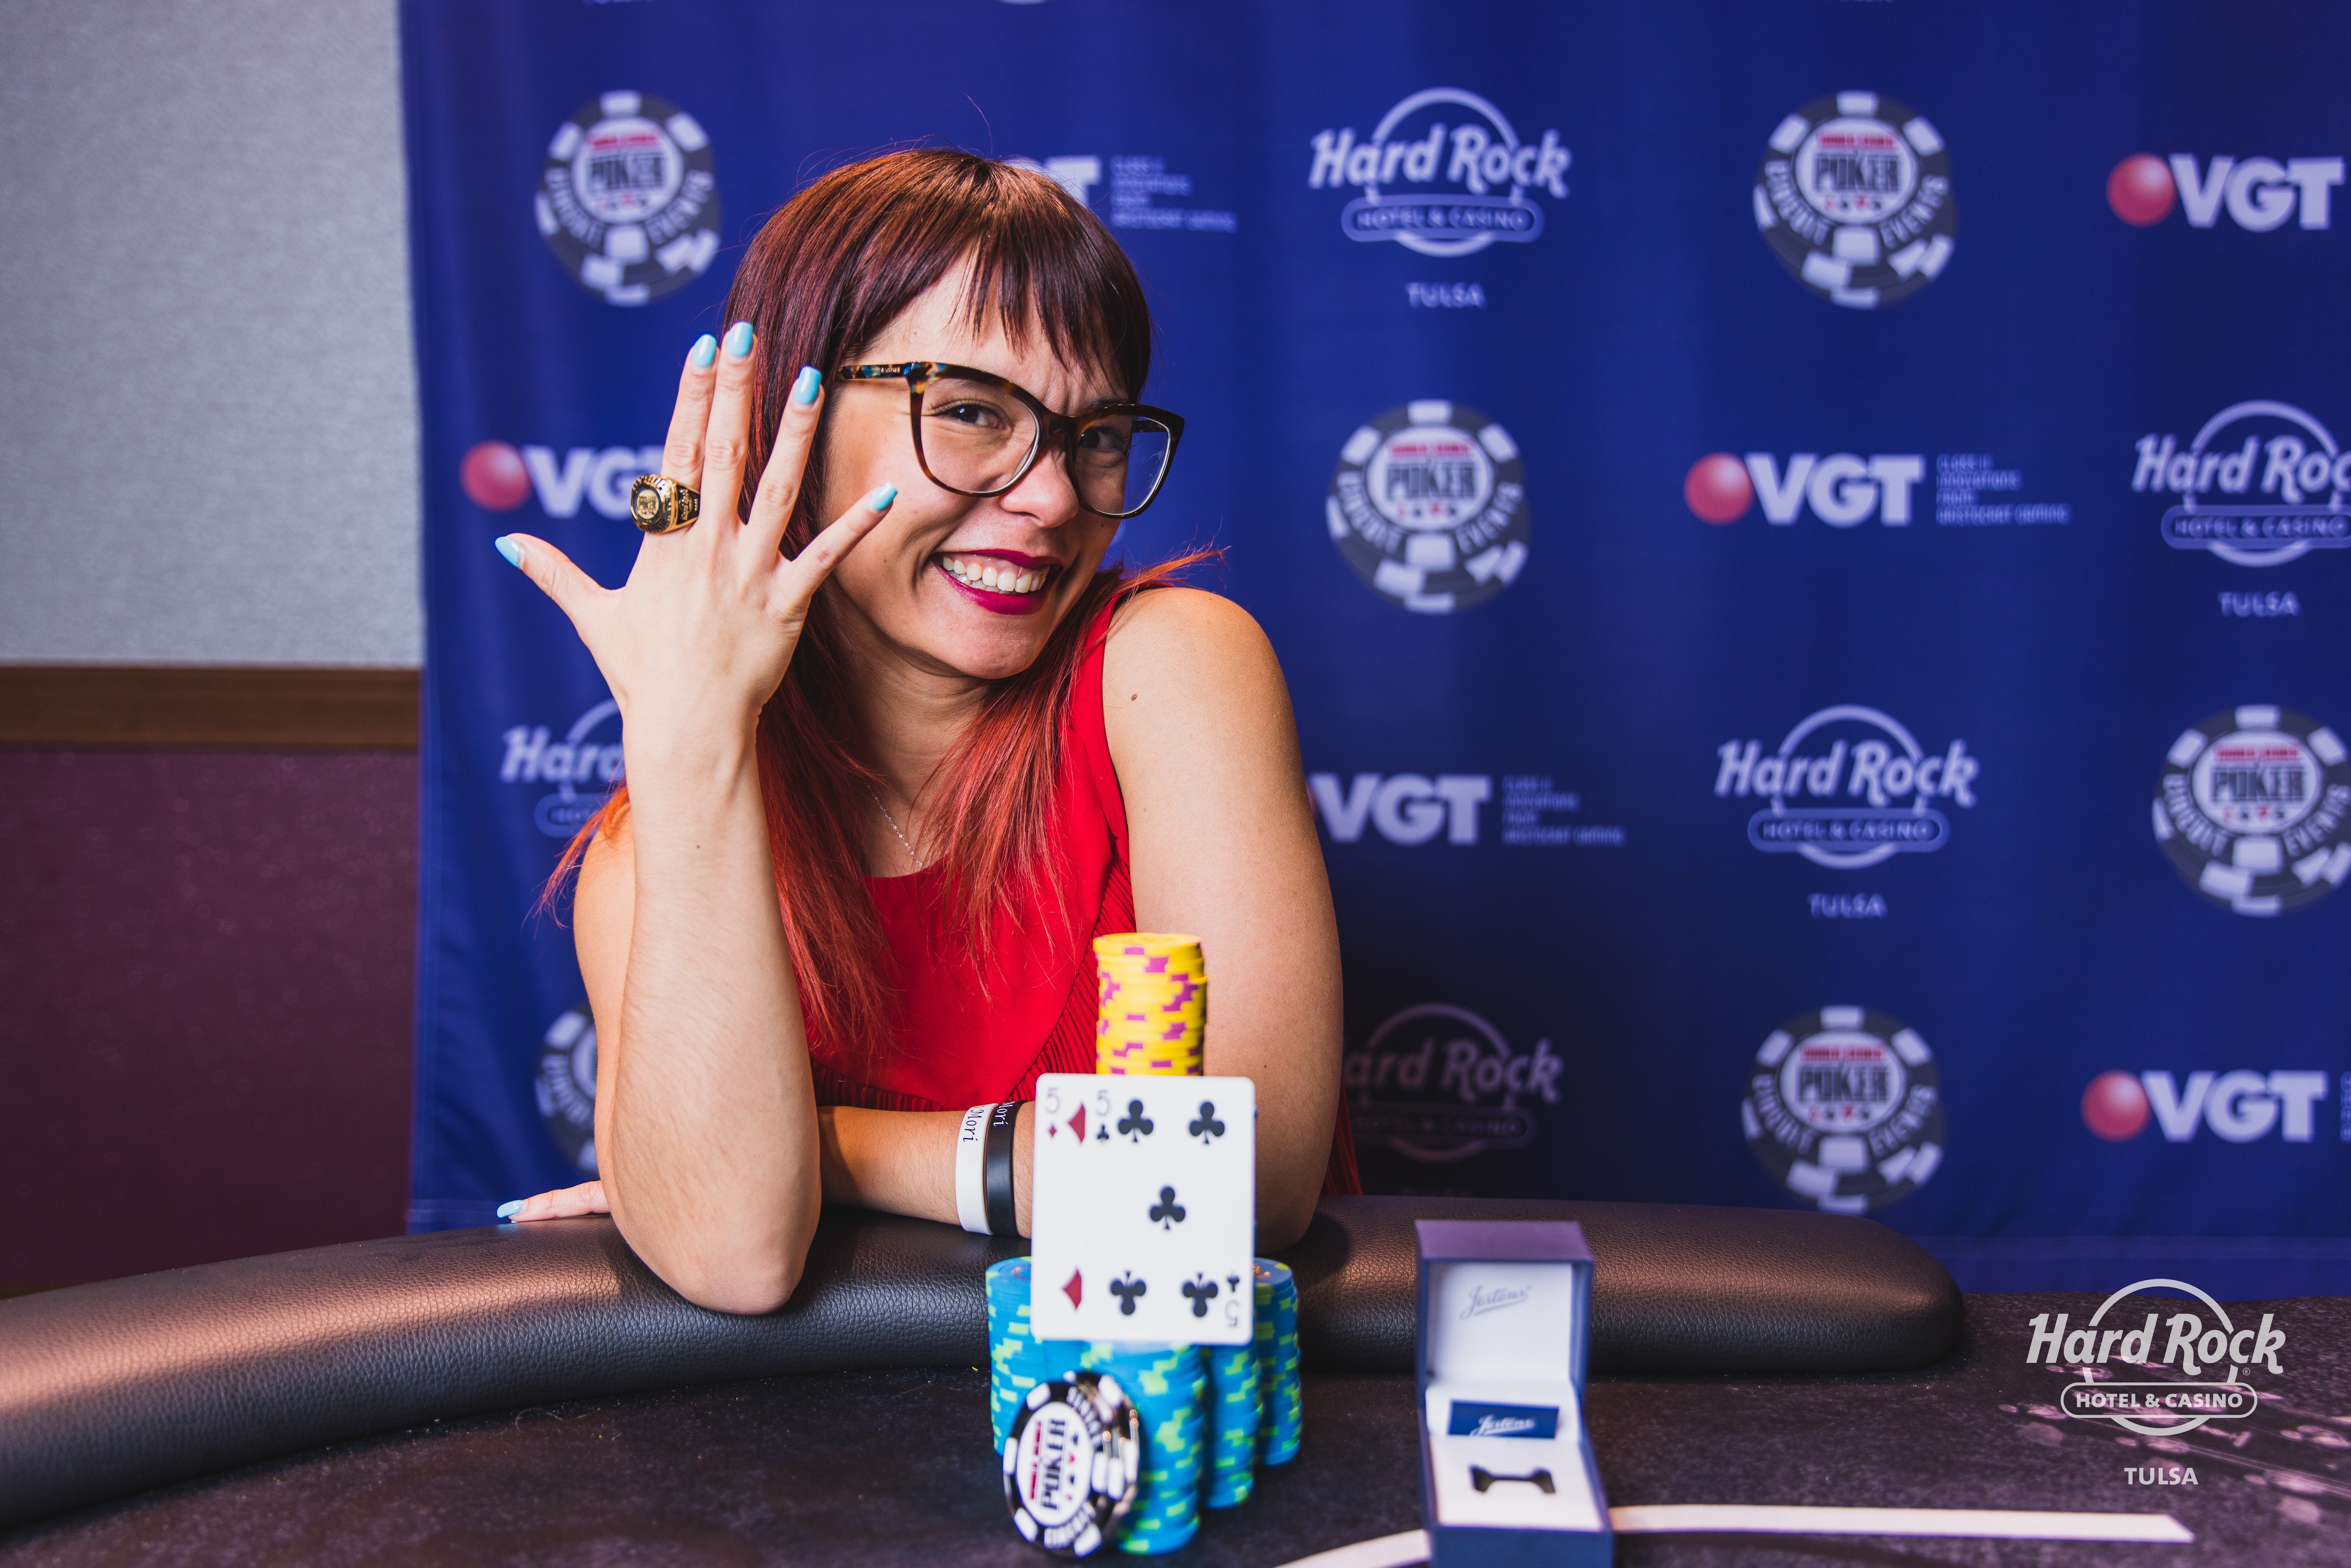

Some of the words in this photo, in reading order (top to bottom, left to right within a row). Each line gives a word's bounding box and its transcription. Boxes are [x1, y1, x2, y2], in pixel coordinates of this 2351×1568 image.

[1308, 122, 1447, 189] Hard
[1446, 123, 1572, 198] Rock
[2168, 152, 2346, 233] VGT
[1405, 281, 1487, 308] TULSA
[522, 444, 665, 520] VG
[1744, 451, 1926, 528] VGT
[2131, 433, 2260, 494] Hard
[2260, 434, 2351, 503] Roc
[2217, 591, 2301, 617] TULSA
[1714, 738, 1849, 798] Hard
[1847, 738, 1981, 808] Rock
[1310, 772, 1492, 846] VGT
[1807, 892, 1888, 919] TULSA
[1045, 1087, 1061, 1114] 5
[1096, 1089, 1110, 1117] 5
[1343, 1036, 1438, 1091] ard
[1441, 1035, 1565, 1105] Rock
[963, 1109, 984, 1142] Mori
[993, 1101, 1016, 1127] Mori
[2140, 1069, 2329, 1143] VGT
